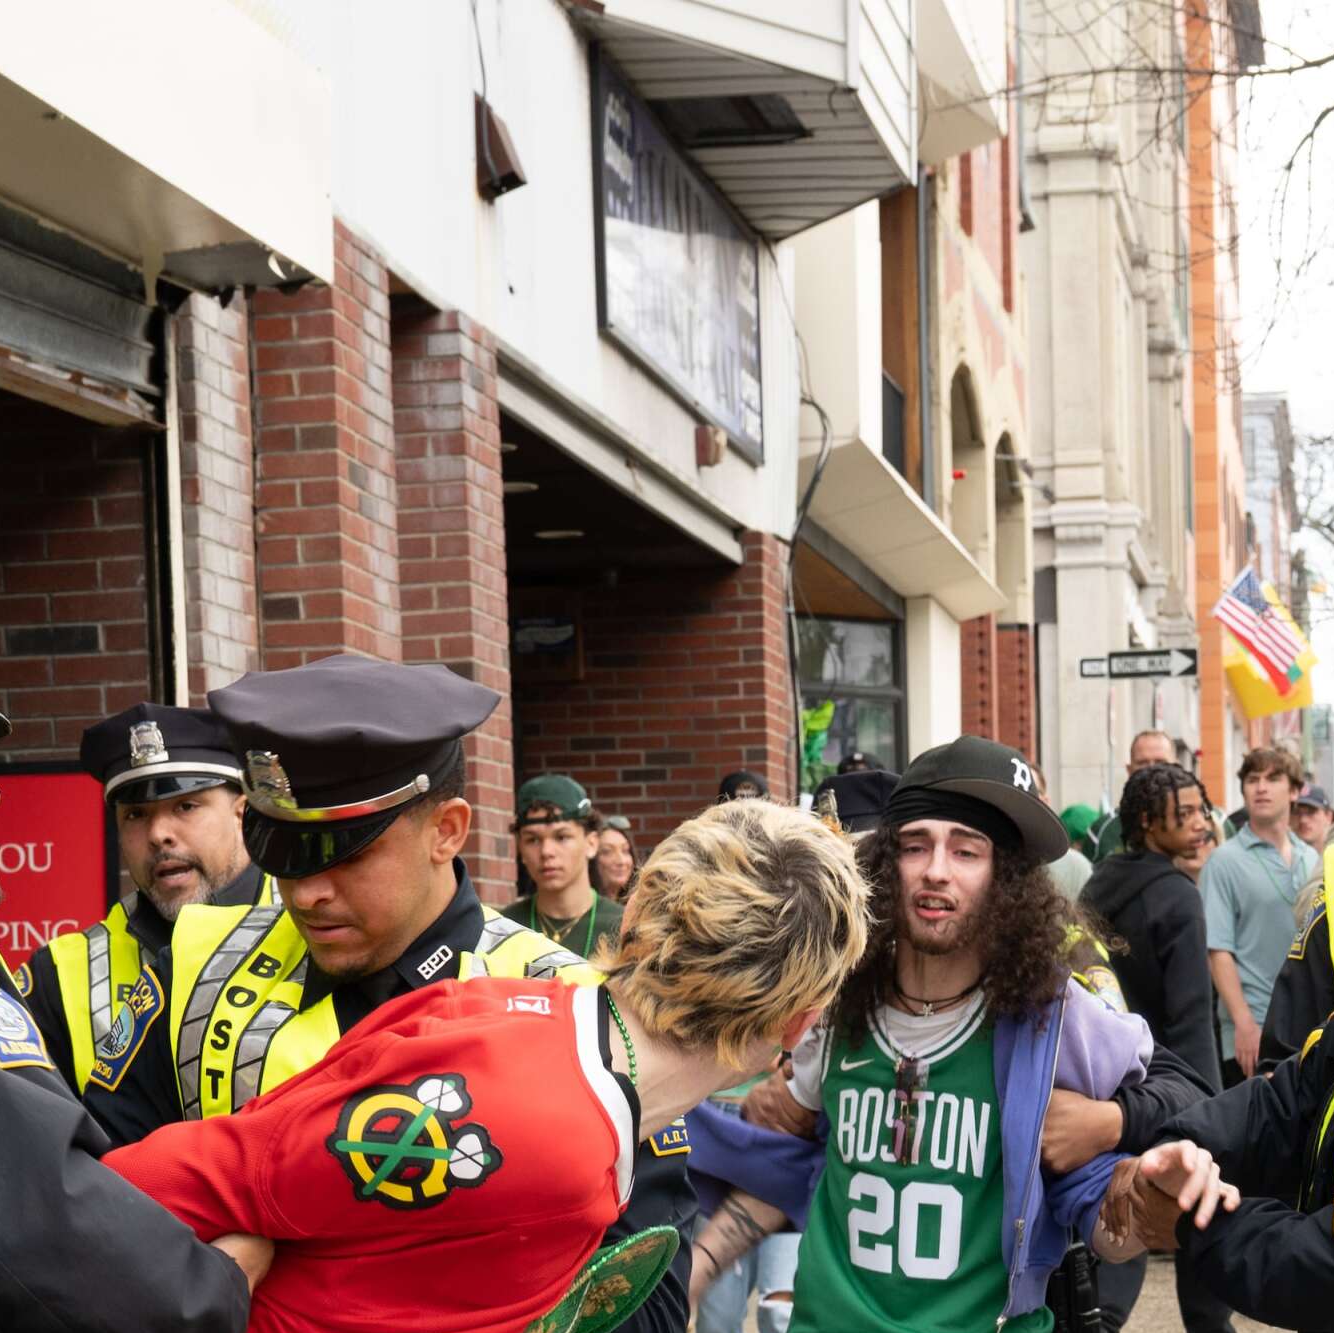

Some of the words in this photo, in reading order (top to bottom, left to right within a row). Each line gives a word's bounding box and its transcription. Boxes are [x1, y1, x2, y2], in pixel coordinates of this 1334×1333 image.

[417, 945, 453, 980] BPD
[205, 952, 283, 1101] BOST
[837, 1087, 991, 1179] BOSTON
[848, 1171, 964, 1280] 20
